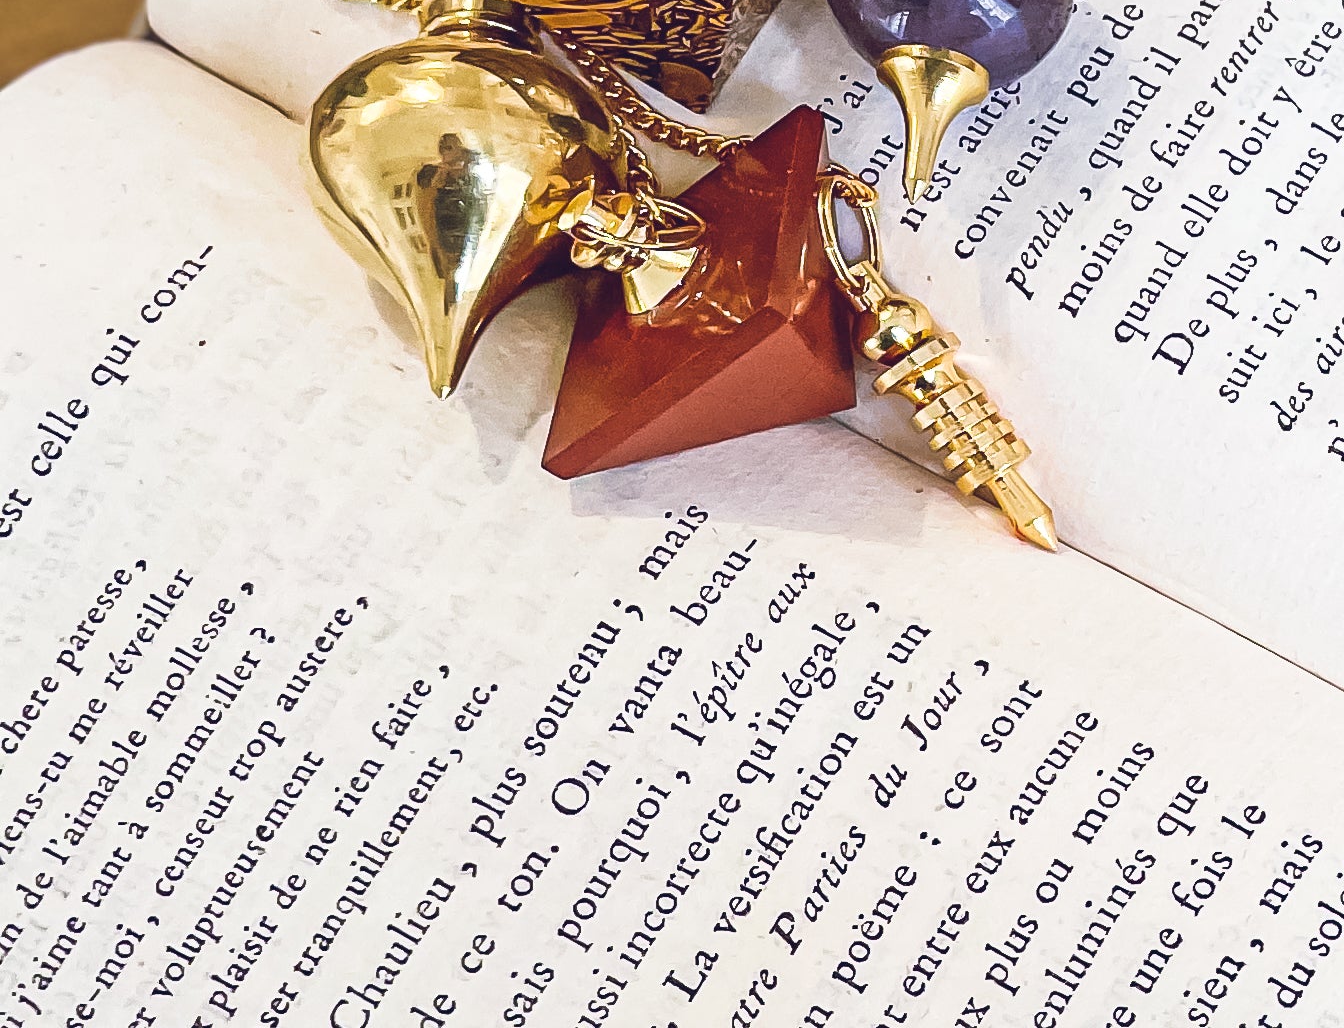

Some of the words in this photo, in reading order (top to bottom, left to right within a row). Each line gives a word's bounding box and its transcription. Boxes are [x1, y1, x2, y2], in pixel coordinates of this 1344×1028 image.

[953, 108, 1070, 261] convenait
[1065, 41, 1116, 109] peu
[1100, 3, 1145, 42] de
[1056, 217, 1134, 320] moins
[1120, 174, 1164, 213] de
[1148, 99, 1216, 170] faire
[1209, 0, 1281, 98] rentrer
[1087, 64, 1163, 171] quand
[1113, 239, 1190, 345] quand
[1179, 183, 1230, 239] elle
[1217, 110, 1281, 177] doit
[1283, 20, 1344, 79] être
[1150, 318, 1212, 377] De
[1264, 146, 1329, 216] dans
[1217, 343, 1269, 405] suit
[1298, 234, 1342, 267] le
[29, 397, 91, 478] celle
[89, 326, 142, 388] qui
[139, 244, 215, 325] com-
[1268, 380, 1315, 433] des
[0, 675, 61, 756] chere
[103, 567, 195, 693] réveiller
[453, 682, 500, 733] etc.
[467, 766, 528, 850] plus
[637, 504, 710, 582] mais
[14, 871, 56, 911] de
[40, 729, 149, 867] l'aimable
[154, 785, 236, 898] censeur
[227, 719, 288, 783] trop
[459, 933, 497, 975] ce
[496, 844, 561, 913] ton.
[550, 758, 613, 817] On
[606, 644, 684, 735] vanta
[668, 537, 759, 628] beau-
[502, 960, 556, 1028] sais
[669, 631, 764, 748] l'épître
[766, 561, 817, 625] aux
[659, 949, 721, 1004] La
[712, 731, 860, 934] versification
[852, 670, 896, 722] est
[885, 623, 934, 666] un
[830, 864, 919, 996] poëme
[979, 678, 1044, 755] sont
[1155, 774, 1210, 838] que
[10, 915, 88, 1017] j'aime
[80, 845, 134, 909] tant
[149, 749, 326, 998] voluptueusement
[207, 914, 280, 1021] plaisir
[267, 873, 308, 911] de
[303, 826, 340, 867] ne
[332, 758, 386, 819] rien
[605, 792, 743, 972] incorrecte
[767, 824, 868, 957] Parties
[866, 762, 909, 810] du
[901, 902, 971, 999] entre
[964, 829, 1017, 895] eux
[1008, 710, 1100, 827] aucune
[983, 913, 1040, 998] plus
[1034, 857, 1075, 905] ou
[1070, 740, 1156, 847] moins
[1128, 927, 1185, 996] une
[1170, 850, 1234, 918] fois
[1219, 804, 1268, 841] le
[1258, 833, 1325, 916] mais
[1266, 960, 1317, 1010] du
